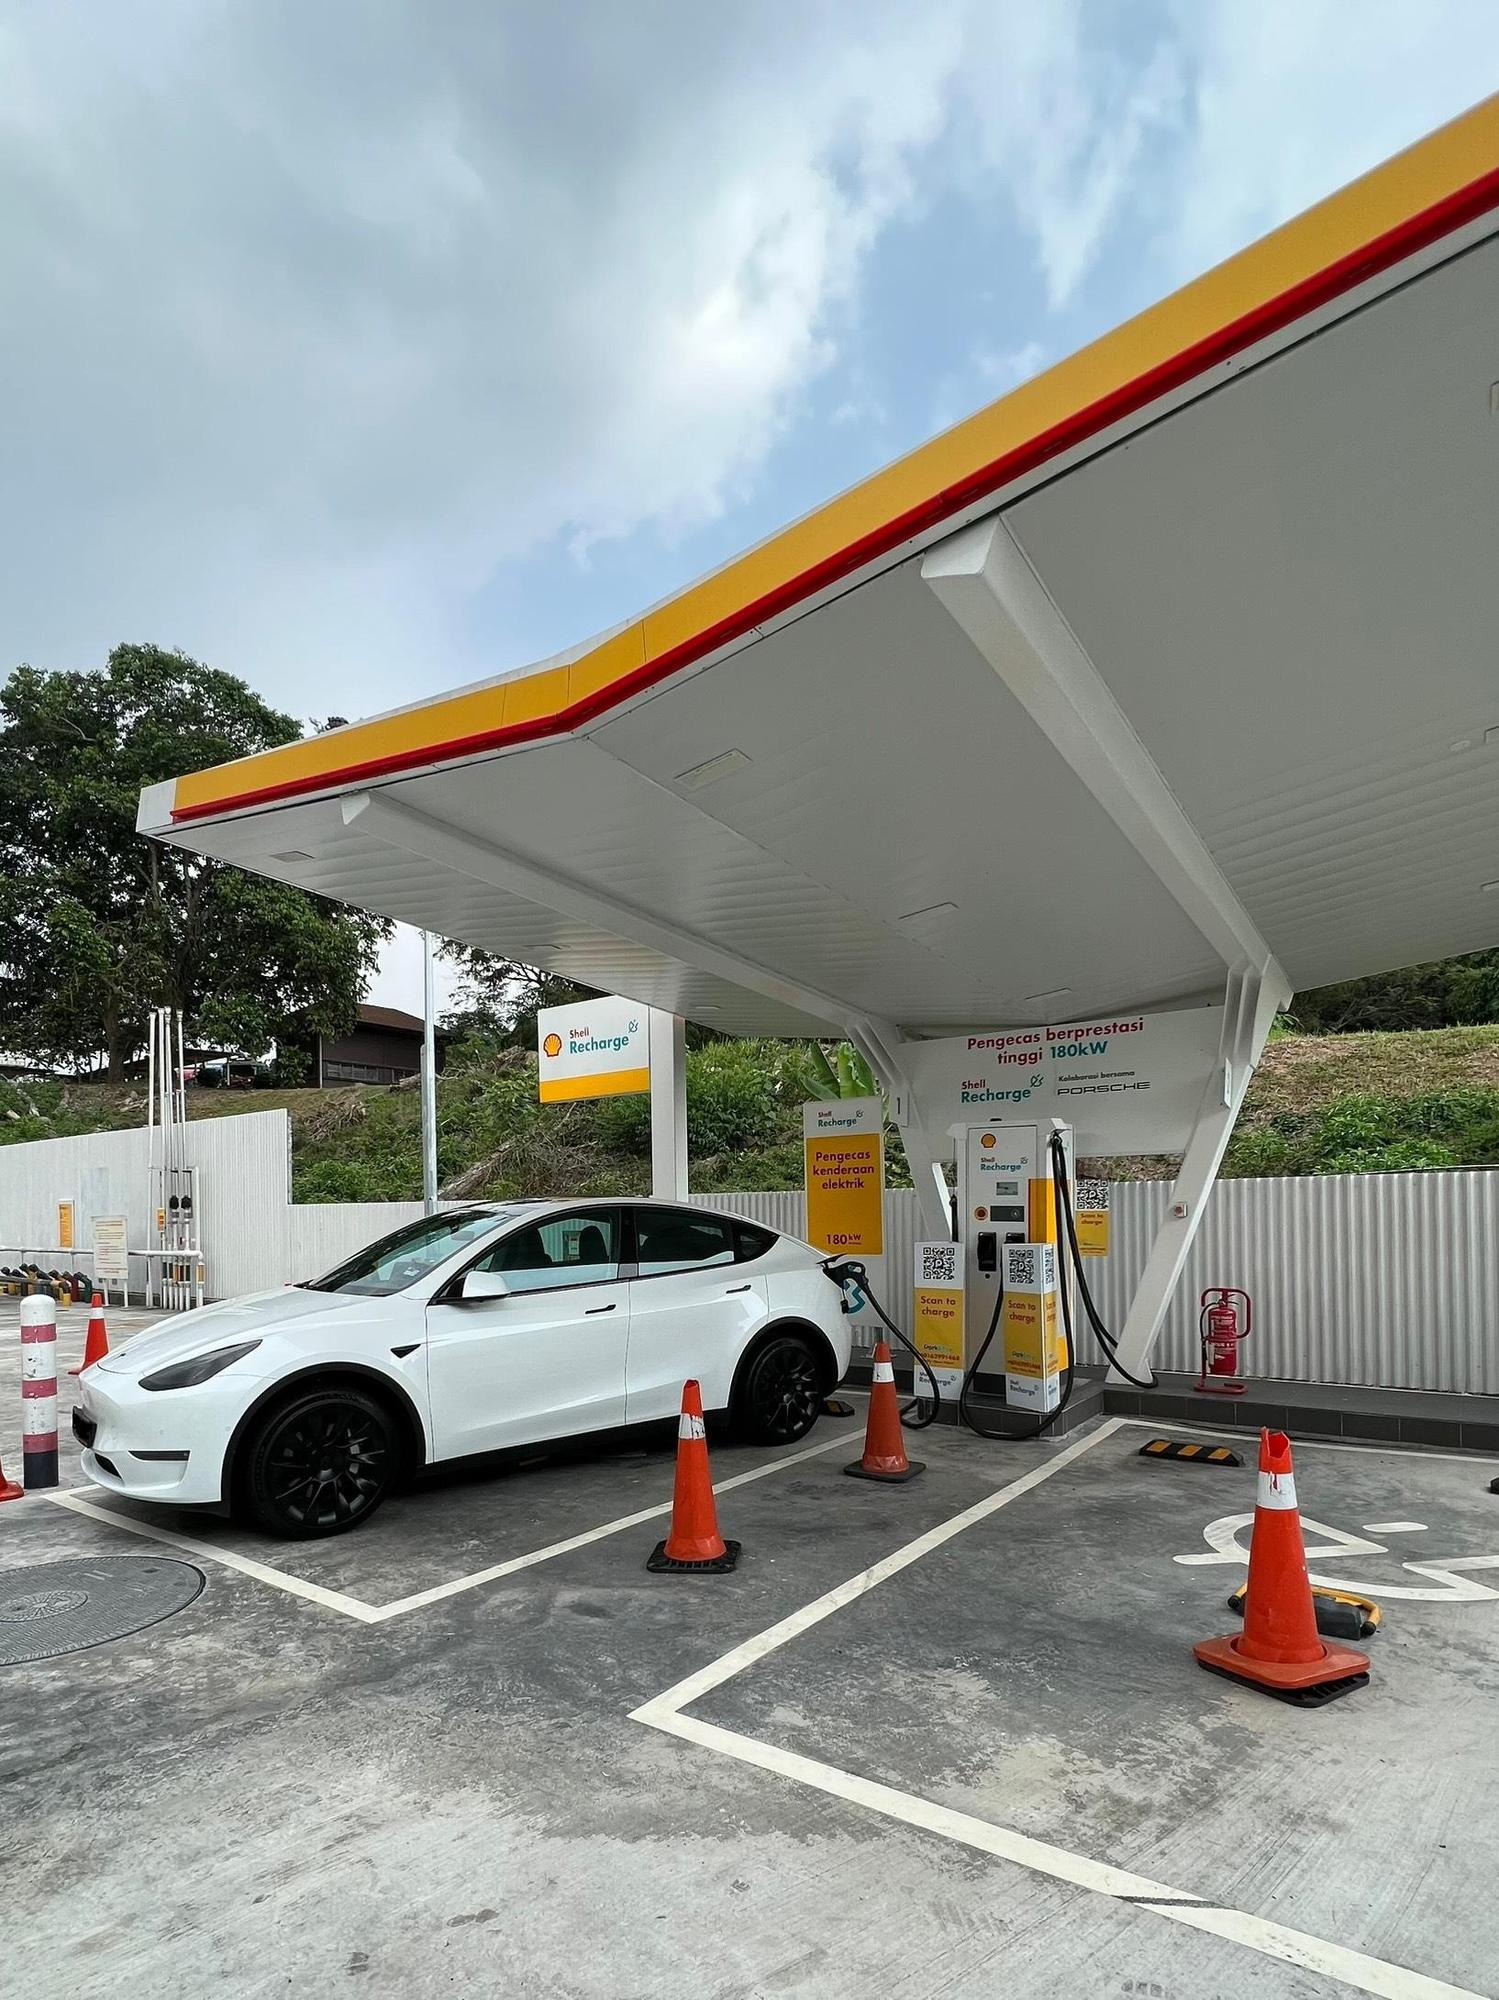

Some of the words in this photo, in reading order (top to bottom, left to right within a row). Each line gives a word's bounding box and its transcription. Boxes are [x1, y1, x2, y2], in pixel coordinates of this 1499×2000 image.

[570, 1027, 589, 1039] Shell
[967, 1031, 1041, 1050] Pengecas
[1046, 1017, 1144, 1042] berprestasi
[570, 1036, 629, 1054] Recharge
[997, 1047, 1043, 1066] tinggi
[1051, 1041, 1108, 1059] 180kW
[1058, 1072, 1099, 1083] Kolaborasi
[1100, 1070, 1136, 1080] bersama
[961, 1079, 986, 1090] Shell
[1057, 1081, 1151, 1096] PORSCHE
[961, 1088, 1031, 1104] Recharge
[818, 1110, 832, 1118] Shell
[818, 1117, 858, 1128] Recharge
[815, 1150, 871, 1164] Pengecas
[812, 1164, 875, 1176] kenderaan
[980, 1162, 1022, 1173] Recharge
[822, 1178, 865, 1190] elektrik
[826, 1234, 848, 1246] 180
[920, 1295, 944, 1306] Scan
[946, 1297, 957, 1306] to
[1007, 1299, 1026, 1311] Scan
[1027, 1301, 1037, 1312] to
[921, 1307, 956, 1319] charge
[1008, 1312, 1036, 1325] charge
